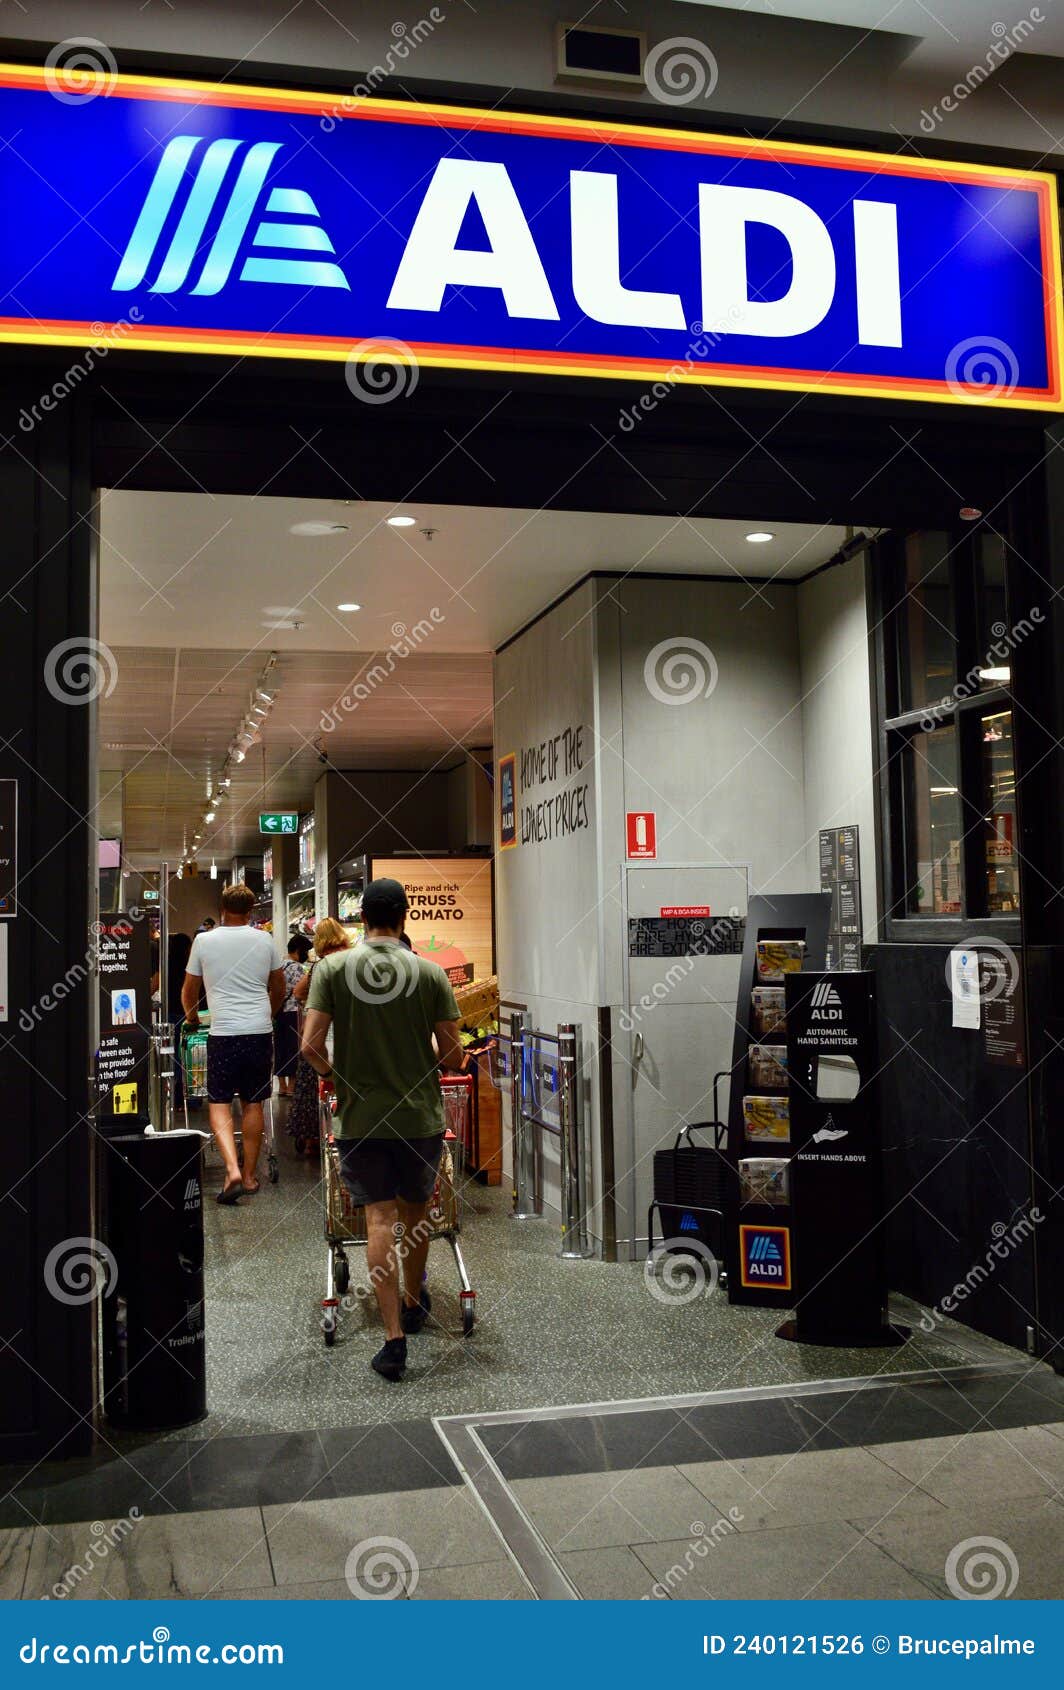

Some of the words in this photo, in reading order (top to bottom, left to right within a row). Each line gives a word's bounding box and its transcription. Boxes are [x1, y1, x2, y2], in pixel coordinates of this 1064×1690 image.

[385, 157, 903, 348] ALDI
[520, 742, 547, 794] HOME
[548, 736, 561, 781] OF
[562, 726, 583, 776] THE
[521, 798, 554, 845] LOWEST
[555, 783, 588, 837] PRICES
[404, 884, 424, 893] Ripe
[425, 884, 442, 892] and
[443, 884, 460, 892] rich
[408, 895, 456, 906] TRUSS
[629, 918, 659, 930] FIRE
[637, 930, 666, 942] FIRE
[629, 943, 655, 955] FIRE
[97, 952, 117, 961] atient.
[101, 963, 129, 973] together,
[811, 1009, 843, 1020] ALDI
[806, 1028, 848, 1036] AUTOMATIC
[106, 1037, 119, 1046] safe
[797, 1037, 819, 1045] HAND
[819, 1037, 858, 1046] SANITISER
[99, 1050, 117, 1058] tween
[118, 1046, 132, 1056] each
[109, 1057, 135, 1069] provided
[103, 1071, 114, 1079] the
[114, 1069, 128, 1078] floor
[797, 1153, 819, 1161] INSERT
[820, 1154, 843, 1162] HANDS
[749, 1263, 783, 1277] ALDI
[168, 1333, 196, 1347] Trolley
